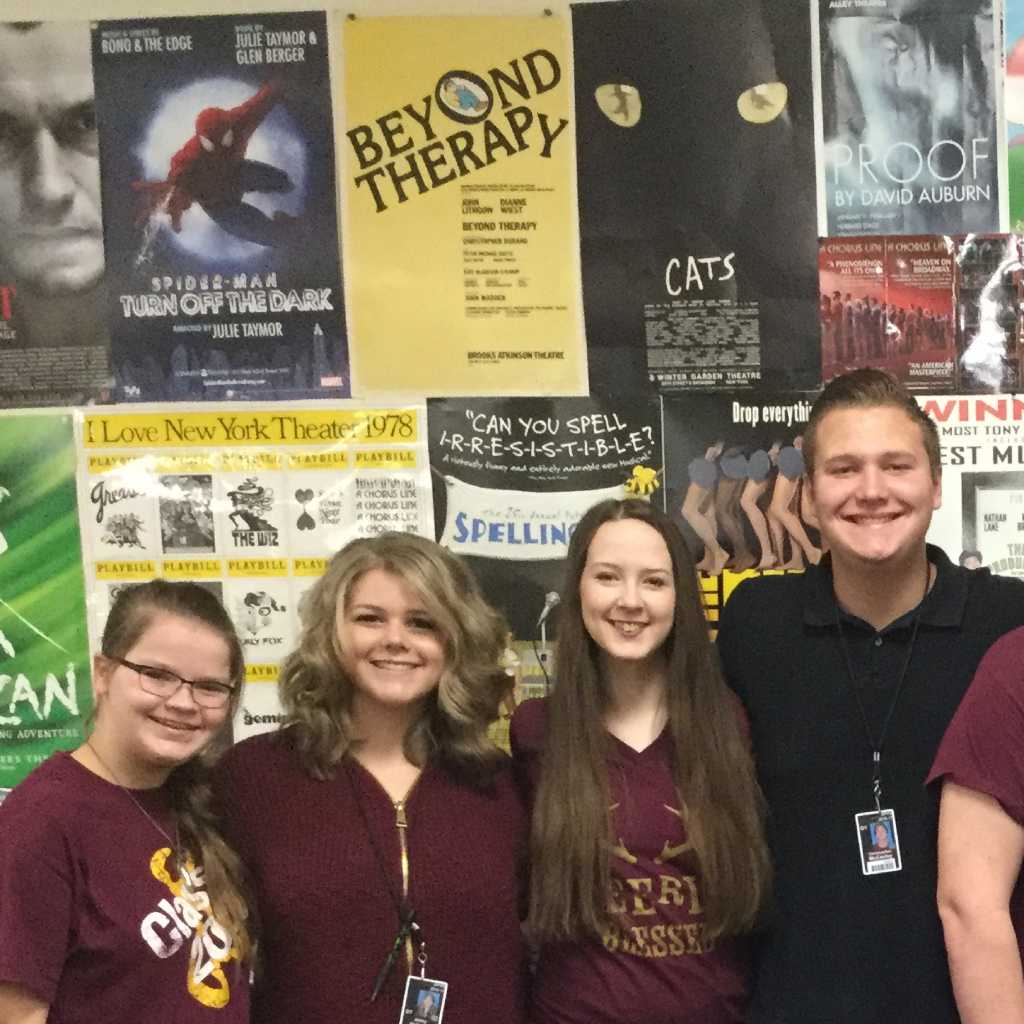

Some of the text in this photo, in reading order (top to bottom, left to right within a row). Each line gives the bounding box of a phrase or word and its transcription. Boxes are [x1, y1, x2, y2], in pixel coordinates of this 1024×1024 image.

[101, 37, 133, 54] BONO
[143, 36, 163, 51] THE
[165, 35, 193, 50] EDGE
[235, 31, 263, 49] JULIE
[265, 30, 307, 47] TAYMOR
[236, 47, 305, 65] GLEN BERGER
[346, 48, 562, 170] BEYOND
[355, 105, 570, 214] THERAPY
[833, 138, 989, 185] PROOF
[835, 185, 991, 207] BY DAVID AUBURN
[462, 222, 537, 231] BEYOND THERAPY
[152, 272, 278, 292] SPIDER-MAN
[665, 252, 736, 296] CATS
[119, 288, 334, 318] TURN OFF THE DARK
[212, 322, 284, 339] JULIE TAYMOR
[657, 372, 761, 381] WINTER GARDEN THEATRE
[732, 401, 759, 427] Drop
[88, 414, 414, 443] I Love New York Theater 1978
[518, 417, 560, 437] YOU
[566, 413, 627, 435] SPELL
[942, 426, 979, 436] MOST
[985, 425, 1021, 436] TONY
[291, 453, 347, 463] LAYBILL
[355, 453, 415, 462] PLAYBILL
[940, 445, 982, 466] EST
[983, 513, 1007, 522] NATHAN
[232, 532, 280, 547] THE WIZ
[96, 558, 328, 573] PLAYBILL PLAYBILL PLAYBILL PLAY
[244, 664, 280, 676] LAYBI
[17, 728, 80, 738] ADVENTURE
